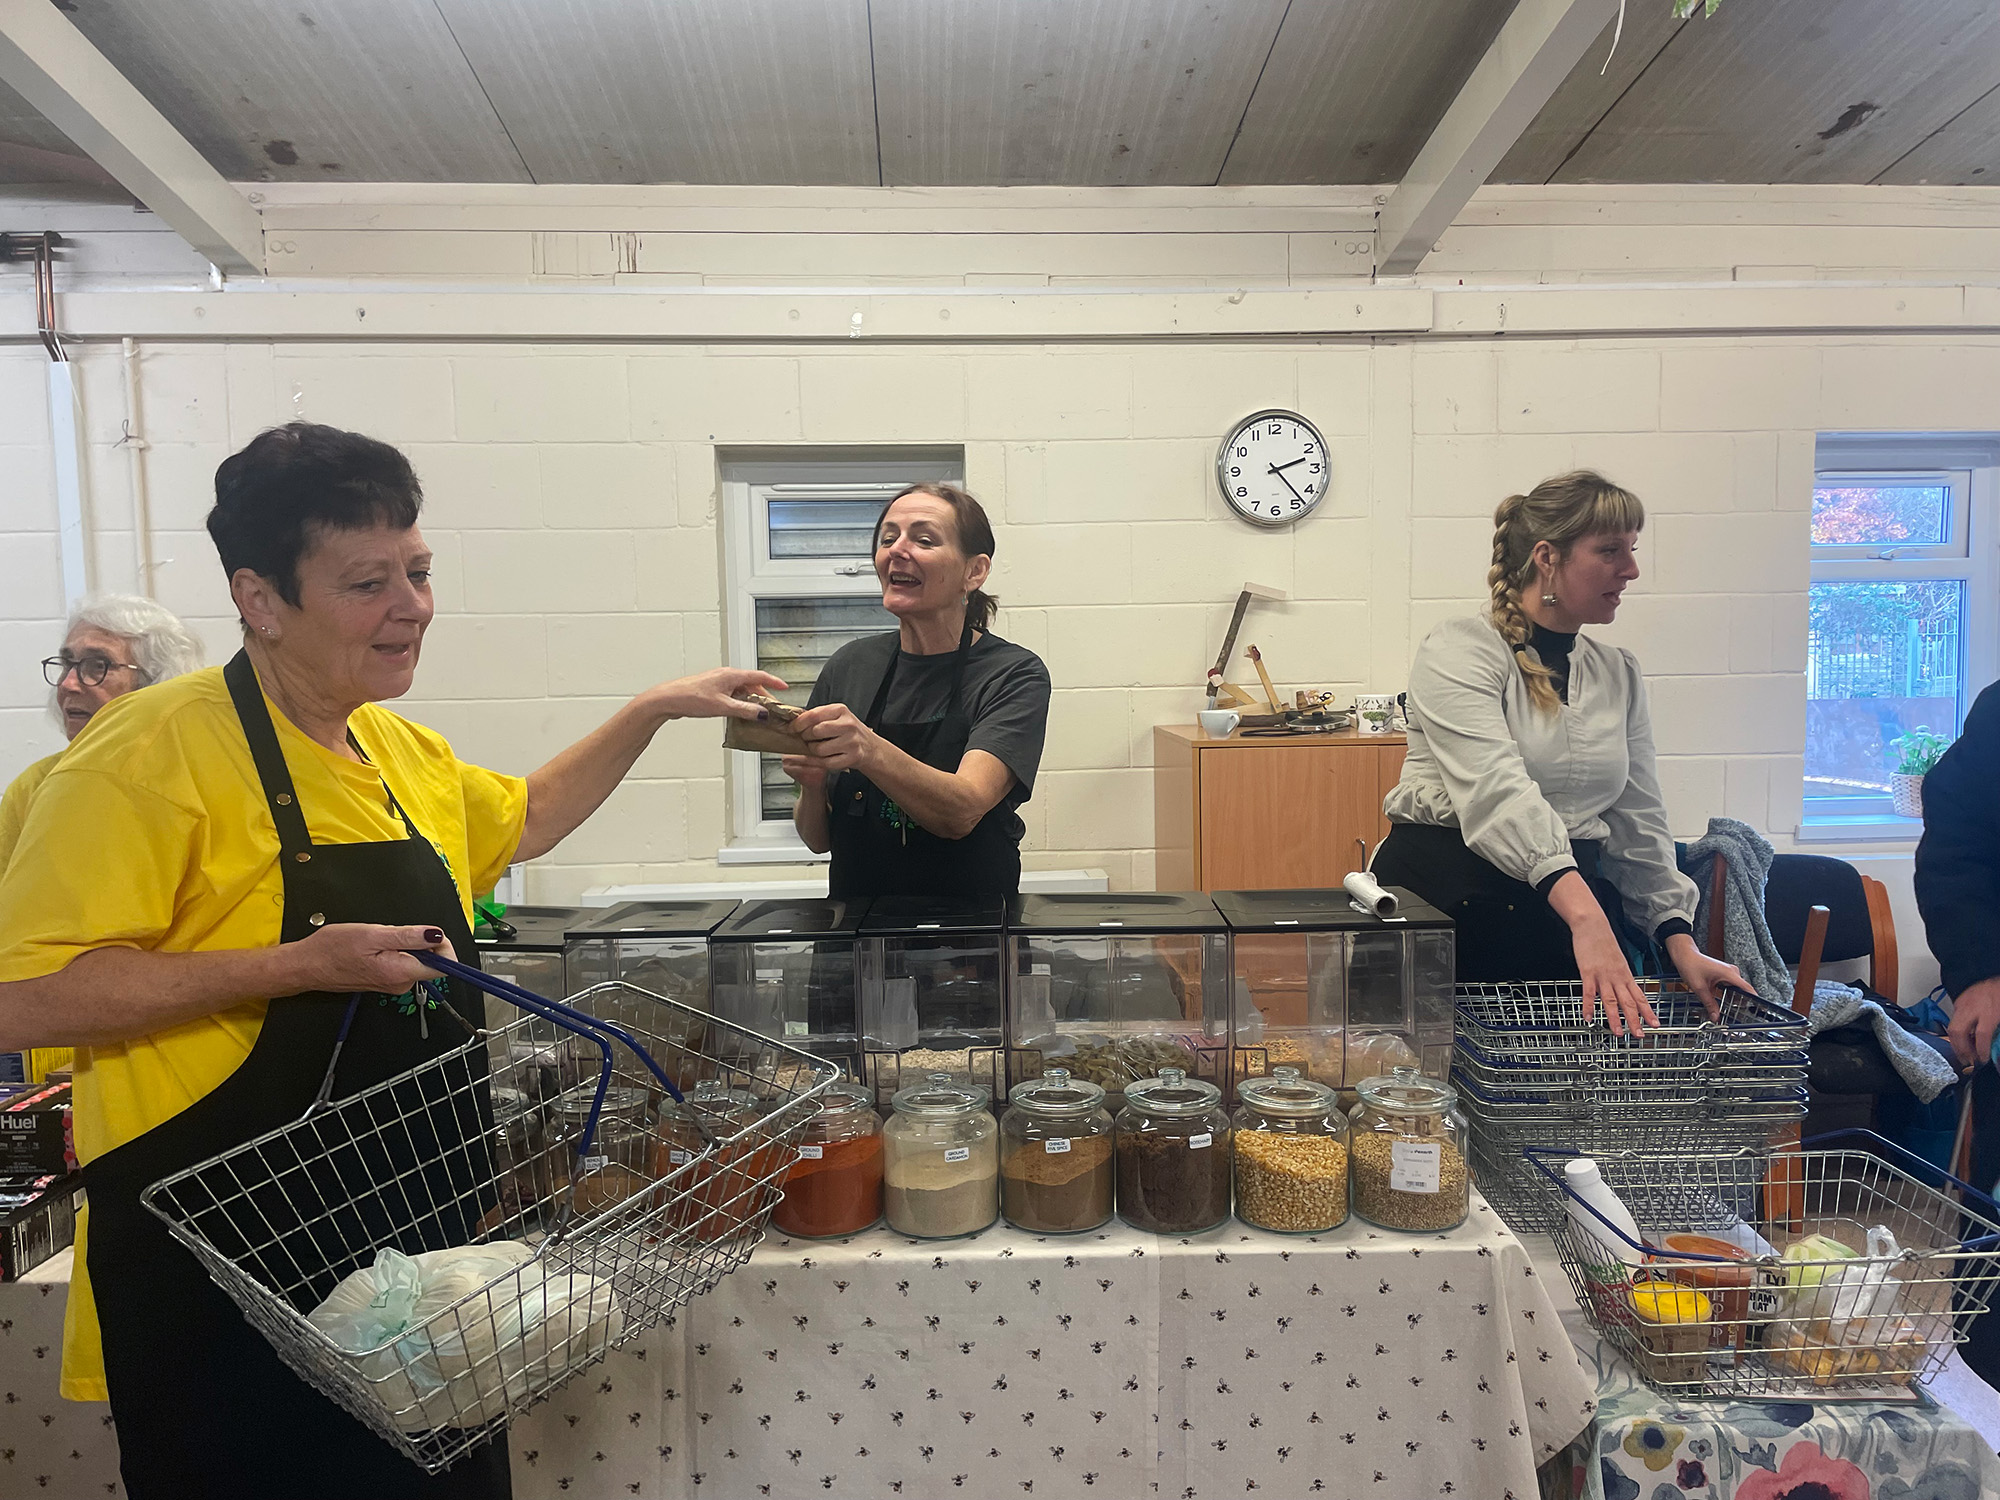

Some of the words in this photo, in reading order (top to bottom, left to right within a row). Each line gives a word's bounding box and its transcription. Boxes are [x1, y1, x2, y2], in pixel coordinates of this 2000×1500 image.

[1268, 424, 1282, 435] 12
[1252, 430, 1260, 441] 11
[1237, 446, 1248, 457] 10
[1303, 443, 1314, 454] 2
[1230, 466, 1241, 477] 9
[1309, 463, 1321, 474] 3
[1236, 486, 1248, 497] 8
[1304, 483, 1315, 494] 4
[1251, 501, 1261, 512] 7
[1290, 499, 1301, 510] 5
[1270, 505, 1281, 516] 6
[1, 1114, 36, 1129] Huel
